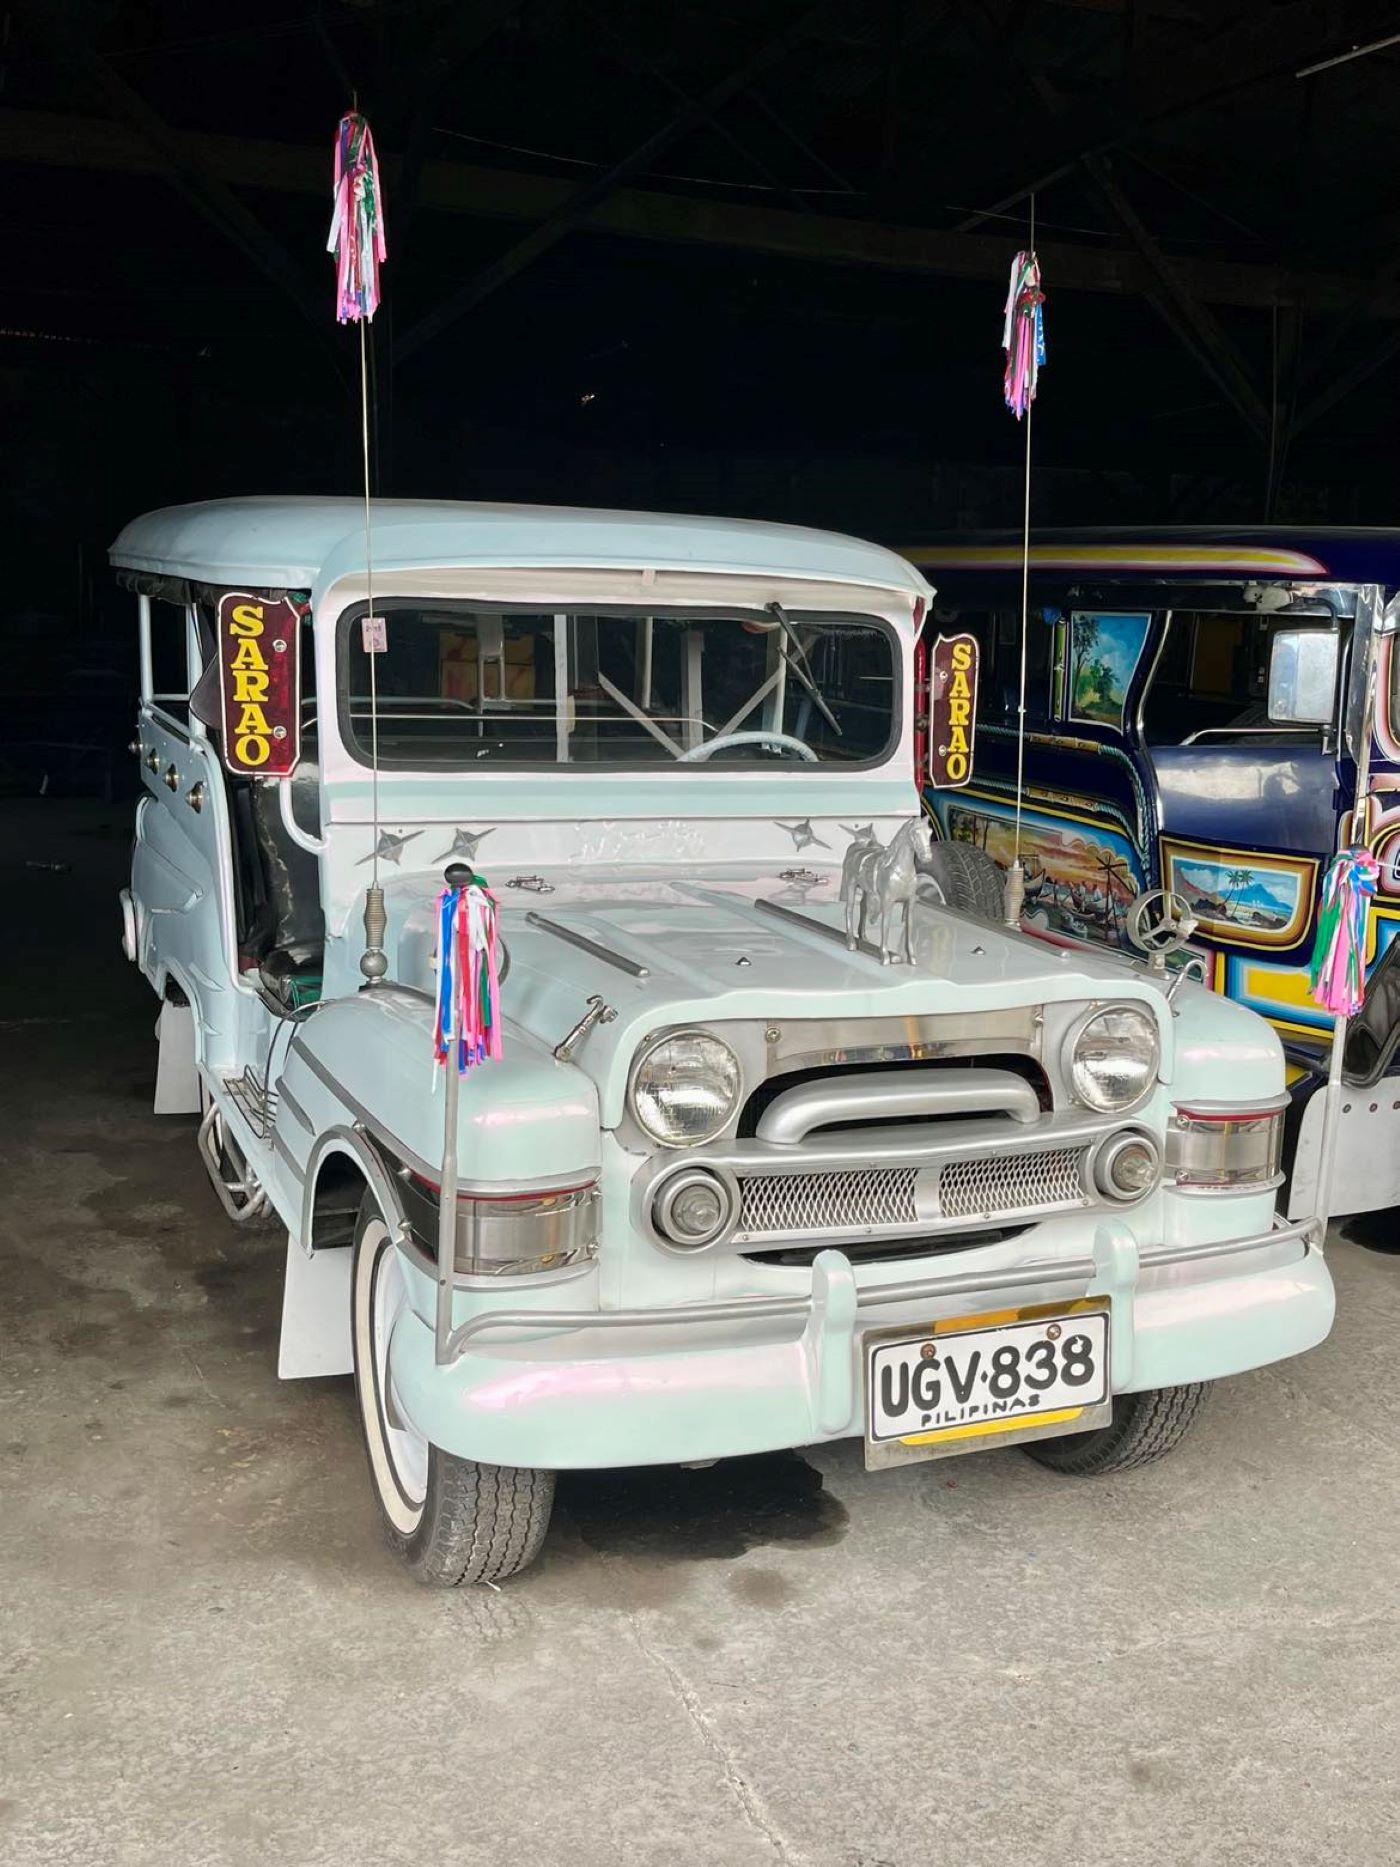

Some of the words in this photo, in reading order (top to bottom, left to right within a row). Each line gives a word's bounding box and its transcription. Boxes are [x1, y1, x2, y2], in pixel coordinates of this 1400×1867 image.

[229, 605, 273, 766] SARAO
[946, 643, 972, 780] SARAO
[920, 1393, 1041, 1427] PILIPINAS
